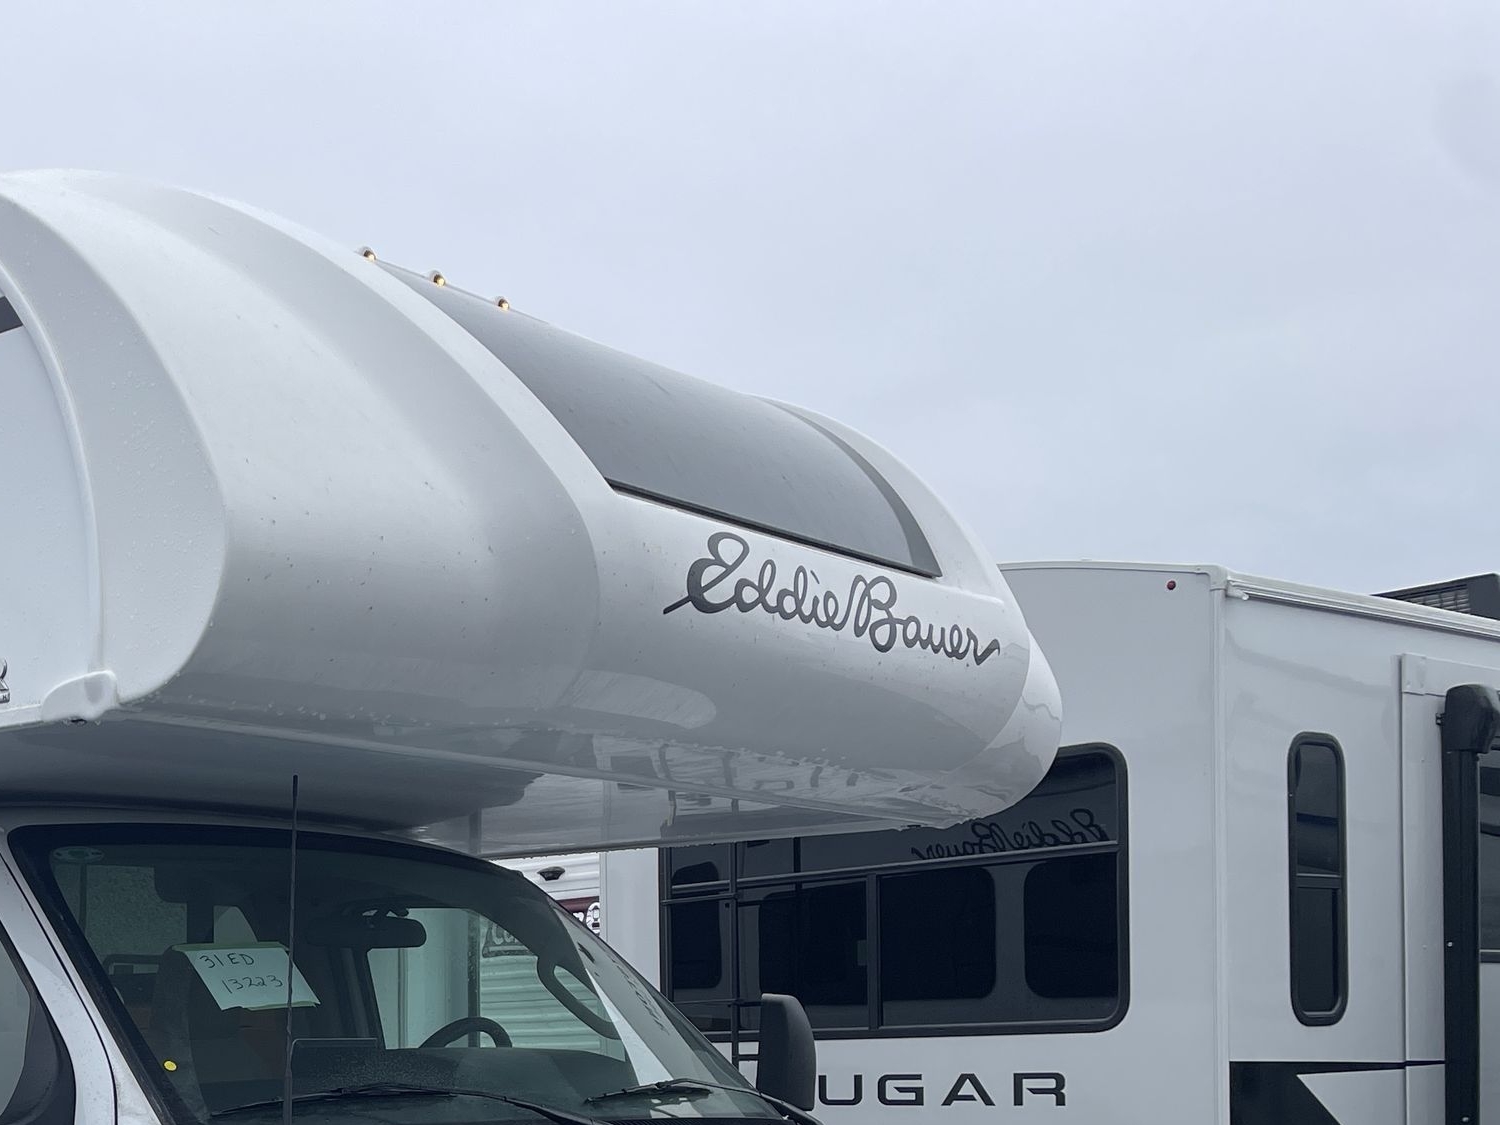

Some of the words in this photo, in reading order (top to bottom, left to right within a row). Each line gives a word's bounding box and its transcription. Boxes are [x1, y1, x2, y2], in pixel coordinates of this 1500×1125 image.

[663, 531, 847, 634] Eddie
[846, 574, 1002, 666] Bauer
[199, 952, 255, 969] 31ED
[222, 974, 284, 994] 13223
[817, 1072, 1067, 1107] UGAR
